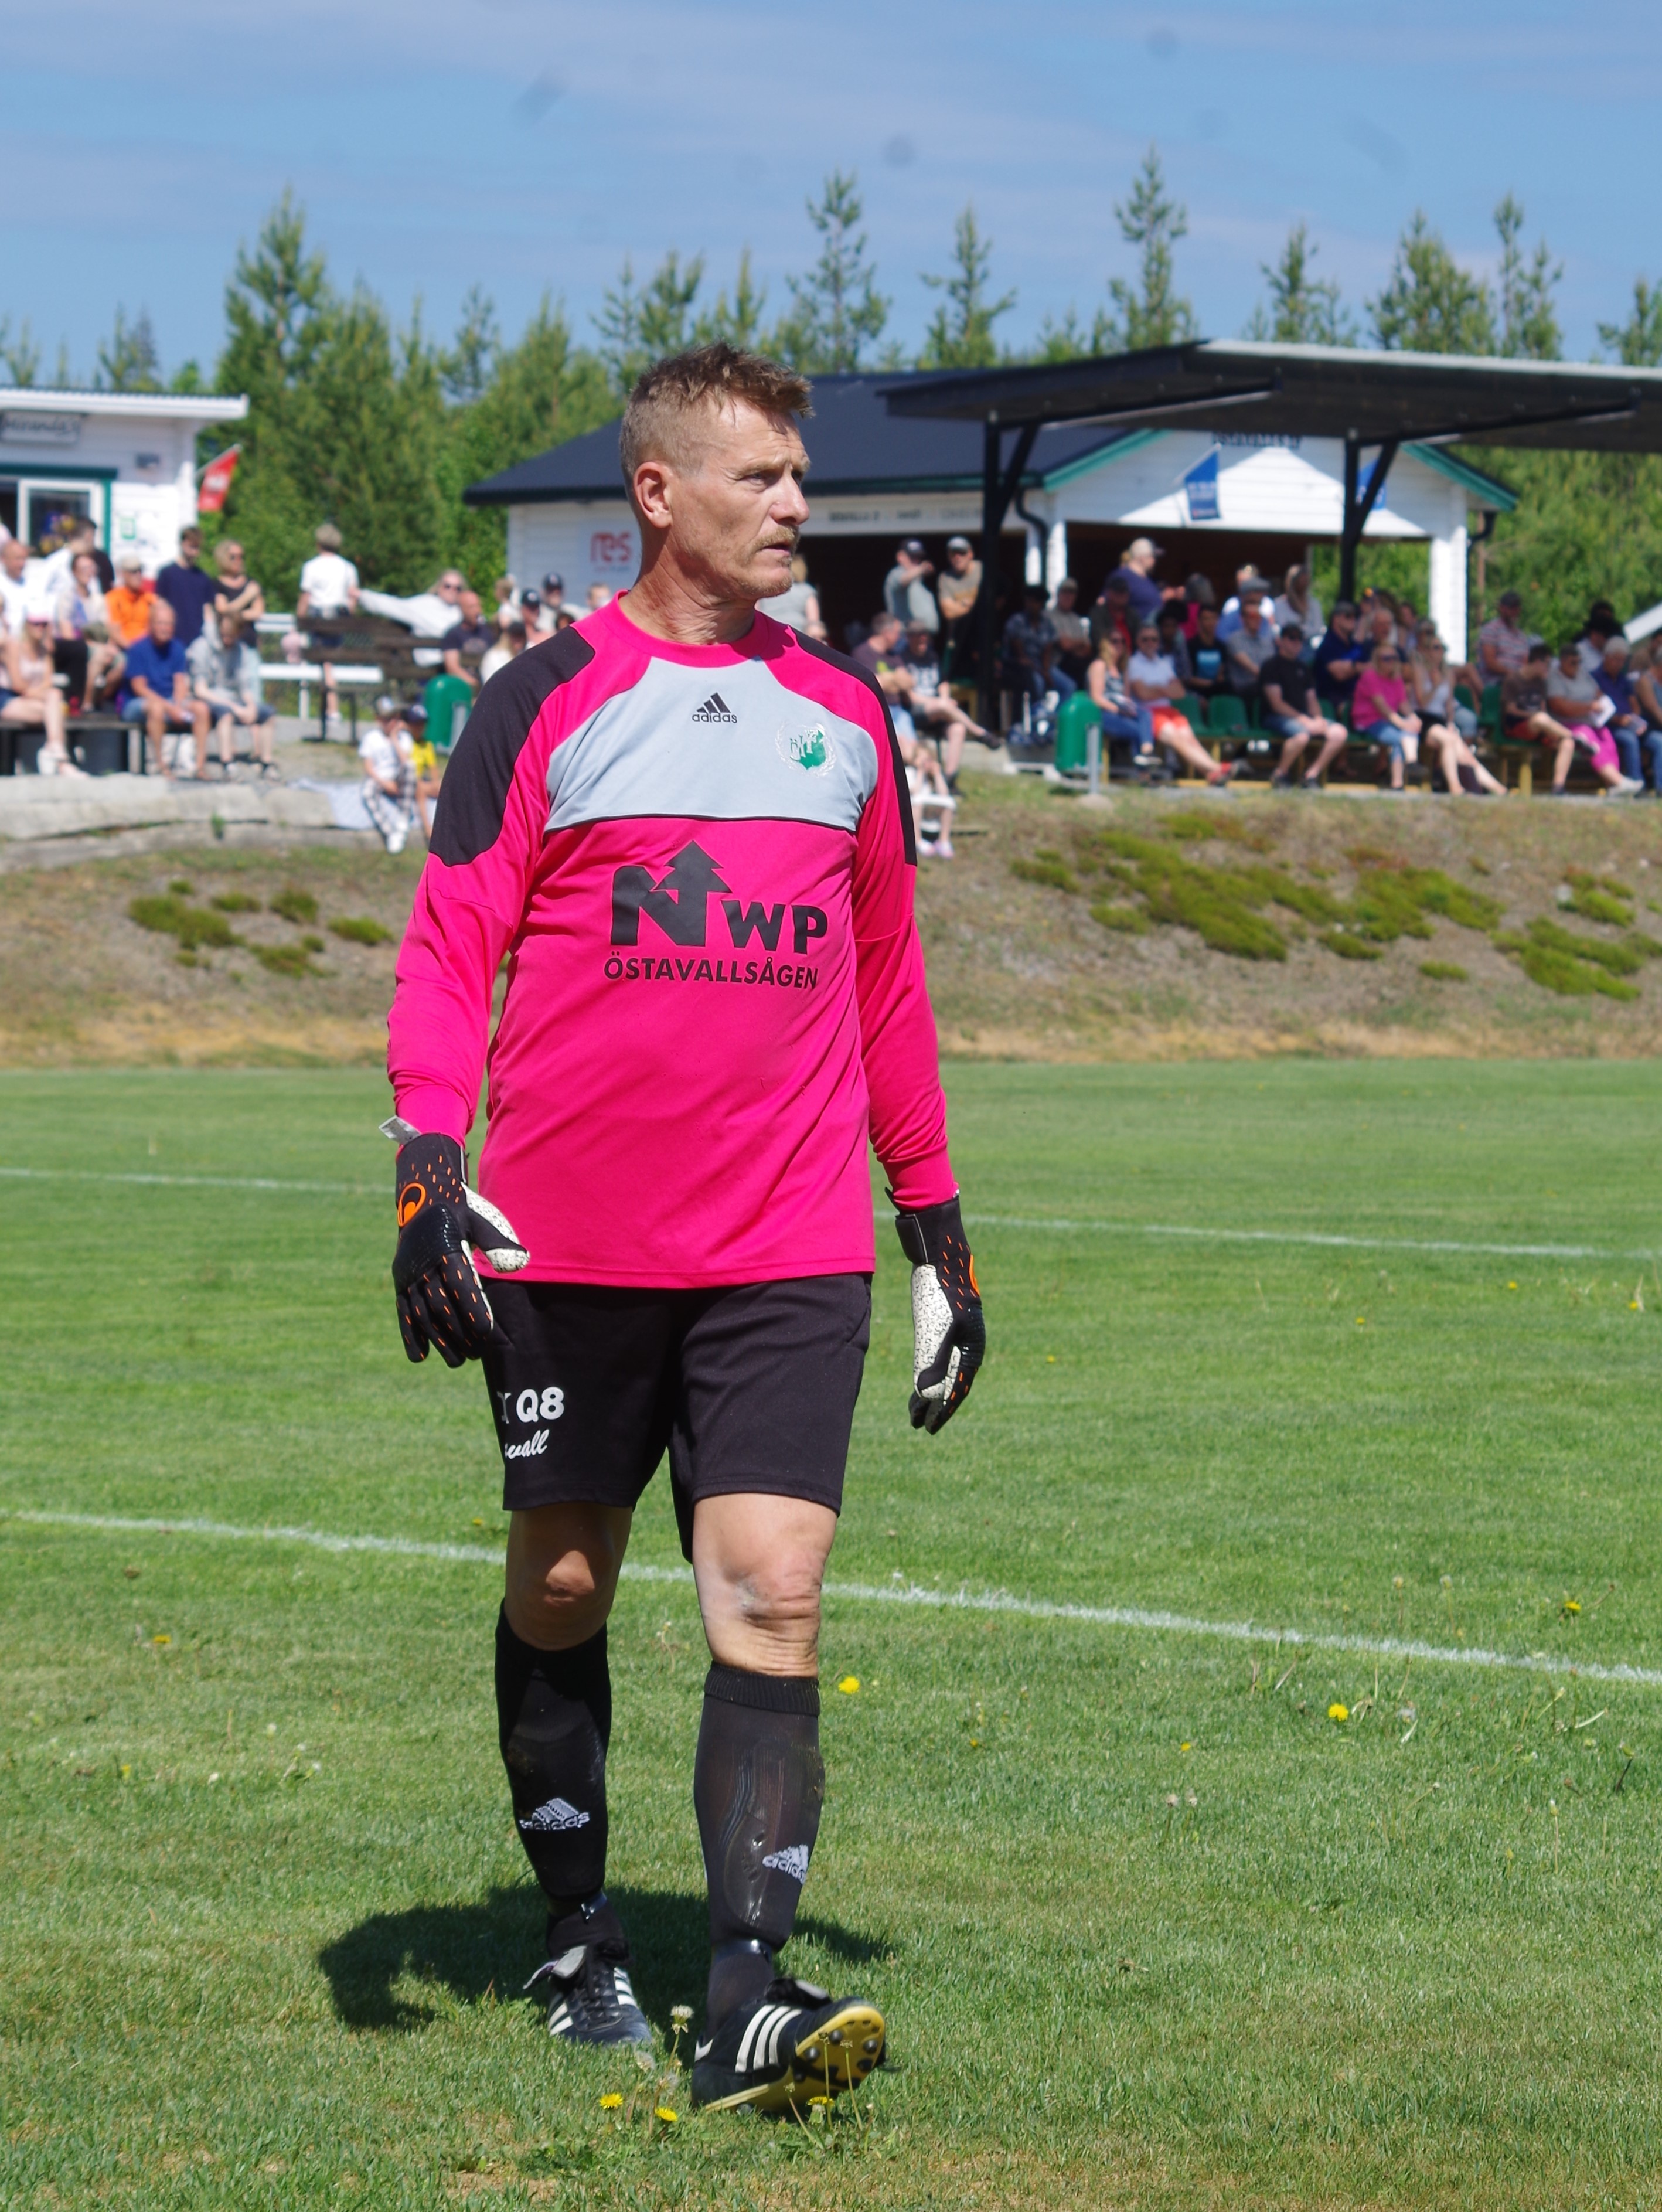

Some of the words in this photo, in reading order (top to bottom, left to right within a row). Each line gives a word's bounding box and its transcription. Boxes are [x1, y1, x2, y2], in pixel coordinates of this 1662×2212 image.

[692, 712, 737, 723] adidas
[604, 951, 819, 990] ÖSTAVALLSÅGEN
[516, 1386, 564, 1423] Q8
[762, 1854, 807, 1886] adida
